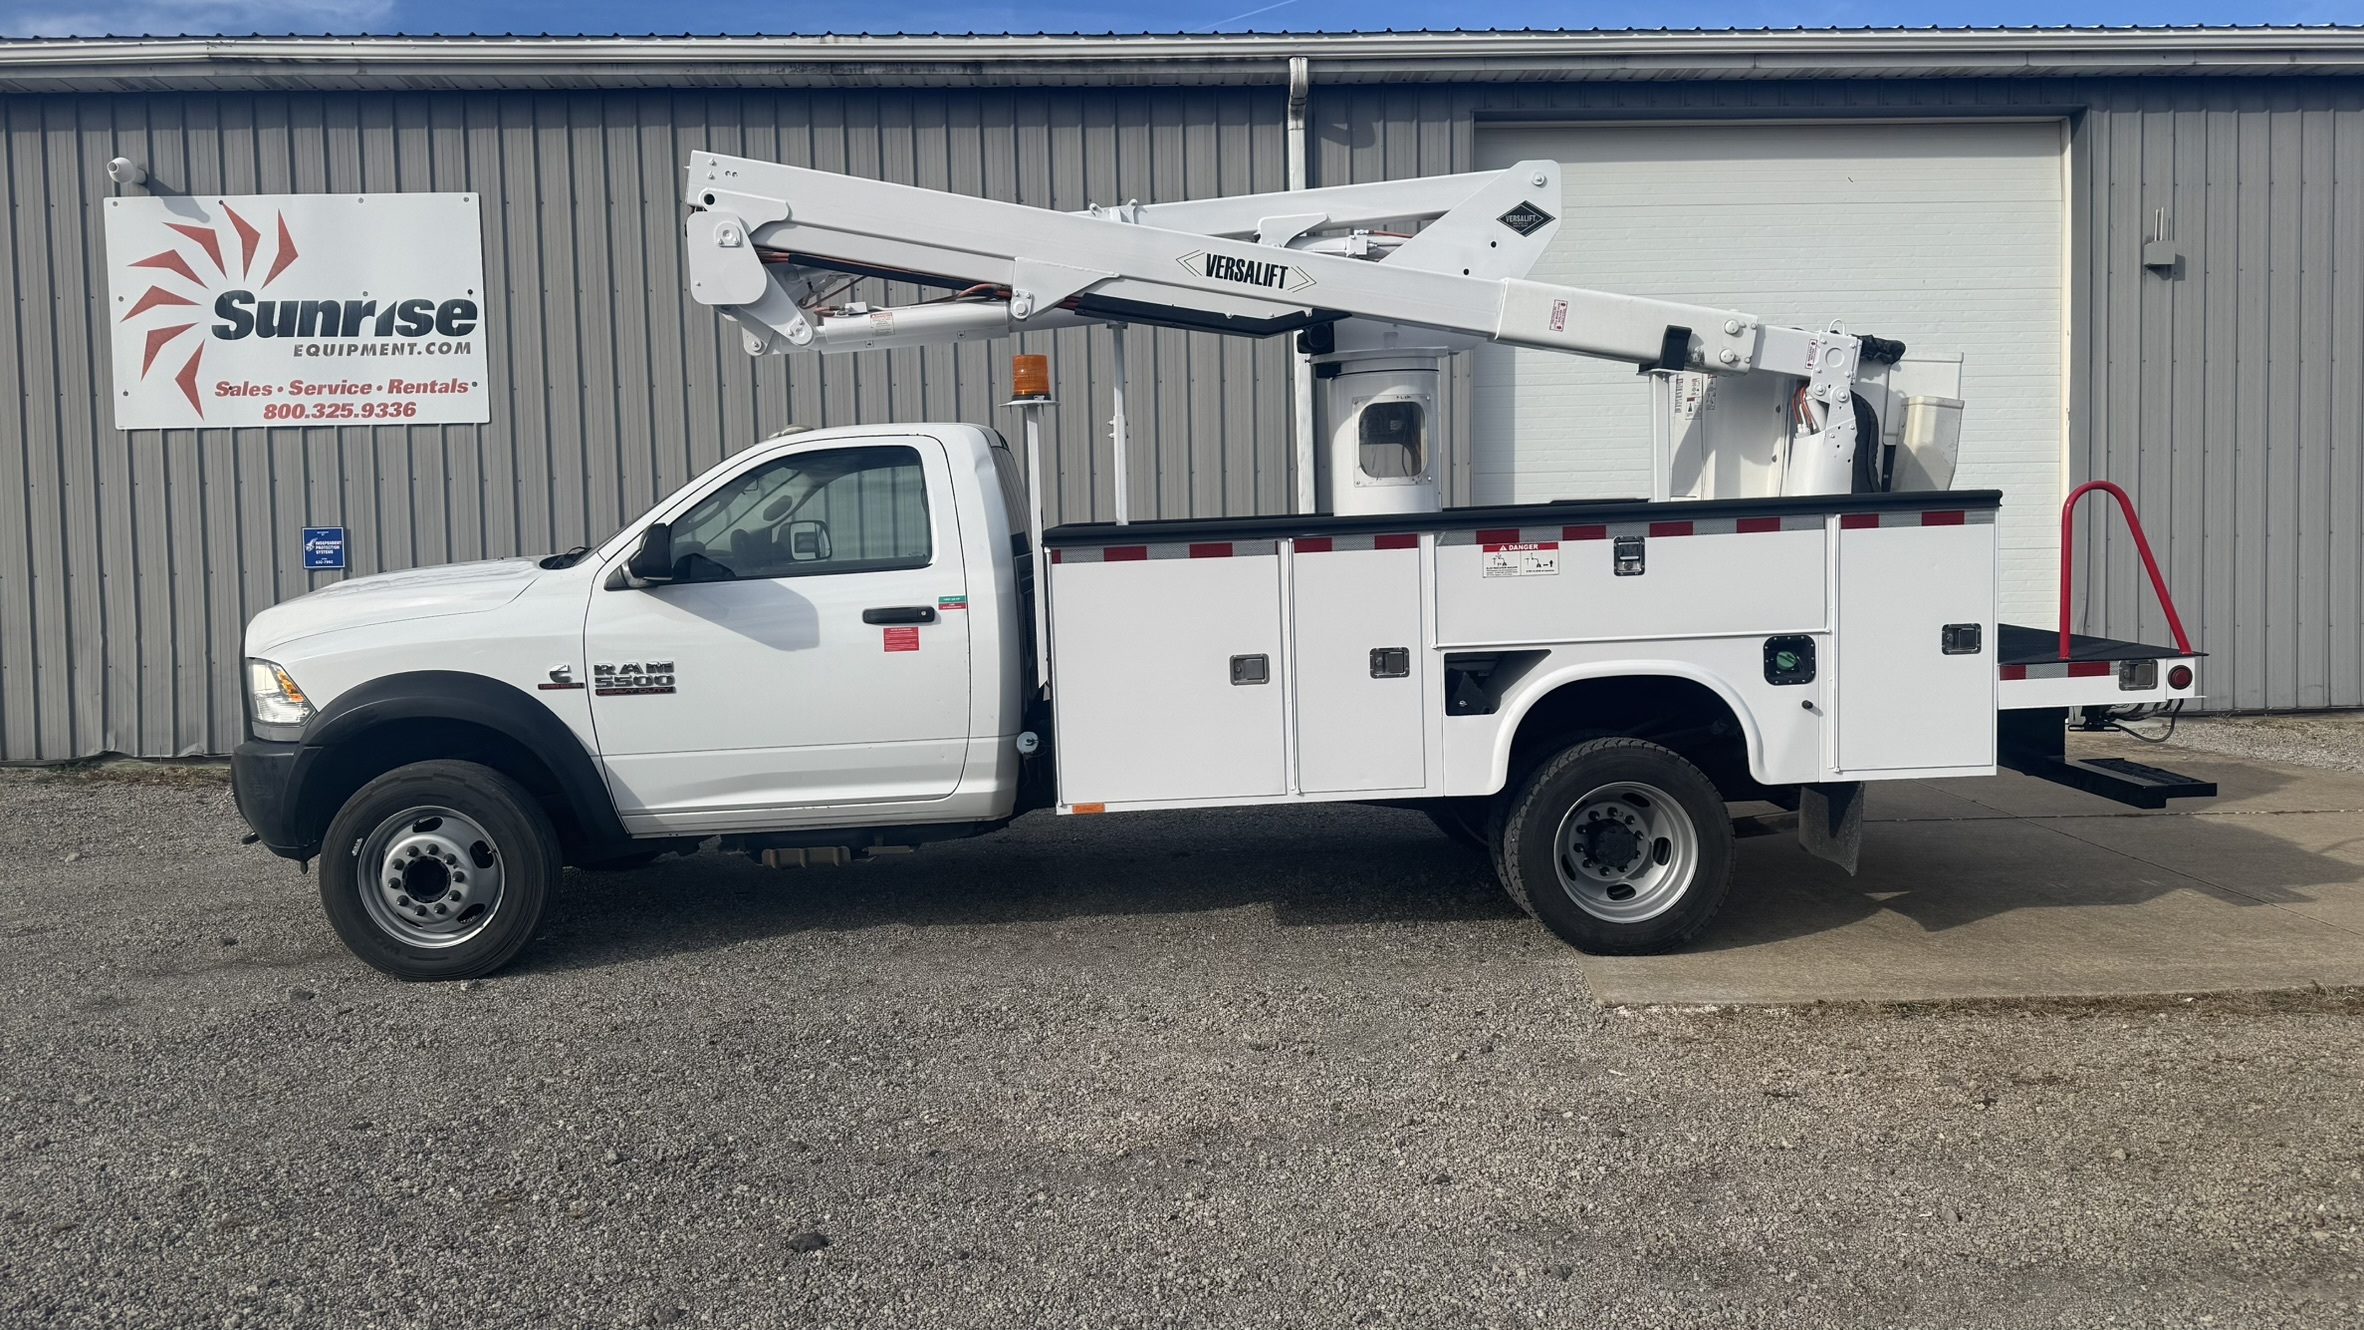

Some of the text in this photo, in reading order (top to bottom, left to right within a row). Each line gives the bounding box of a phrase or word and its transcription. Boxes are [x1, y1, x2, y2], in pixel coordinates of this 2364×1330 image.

[1504, 214, 1537, 223] VERSALIFT
[1205, 252, 1289, 290] VERSALIFT
[211, 289, 478, 341] Sunrise
[293, 341, 472, 358] EQUIPMENT.COM
[214, 378, 469, 397] Sales Service Rentals
[263, 401, 417, 420] 800.325.9336
[1508, 543, 1539, 551] DANGER
[593, 661, 675, 675] RAM
[594, 674, 676, 688] 5500
